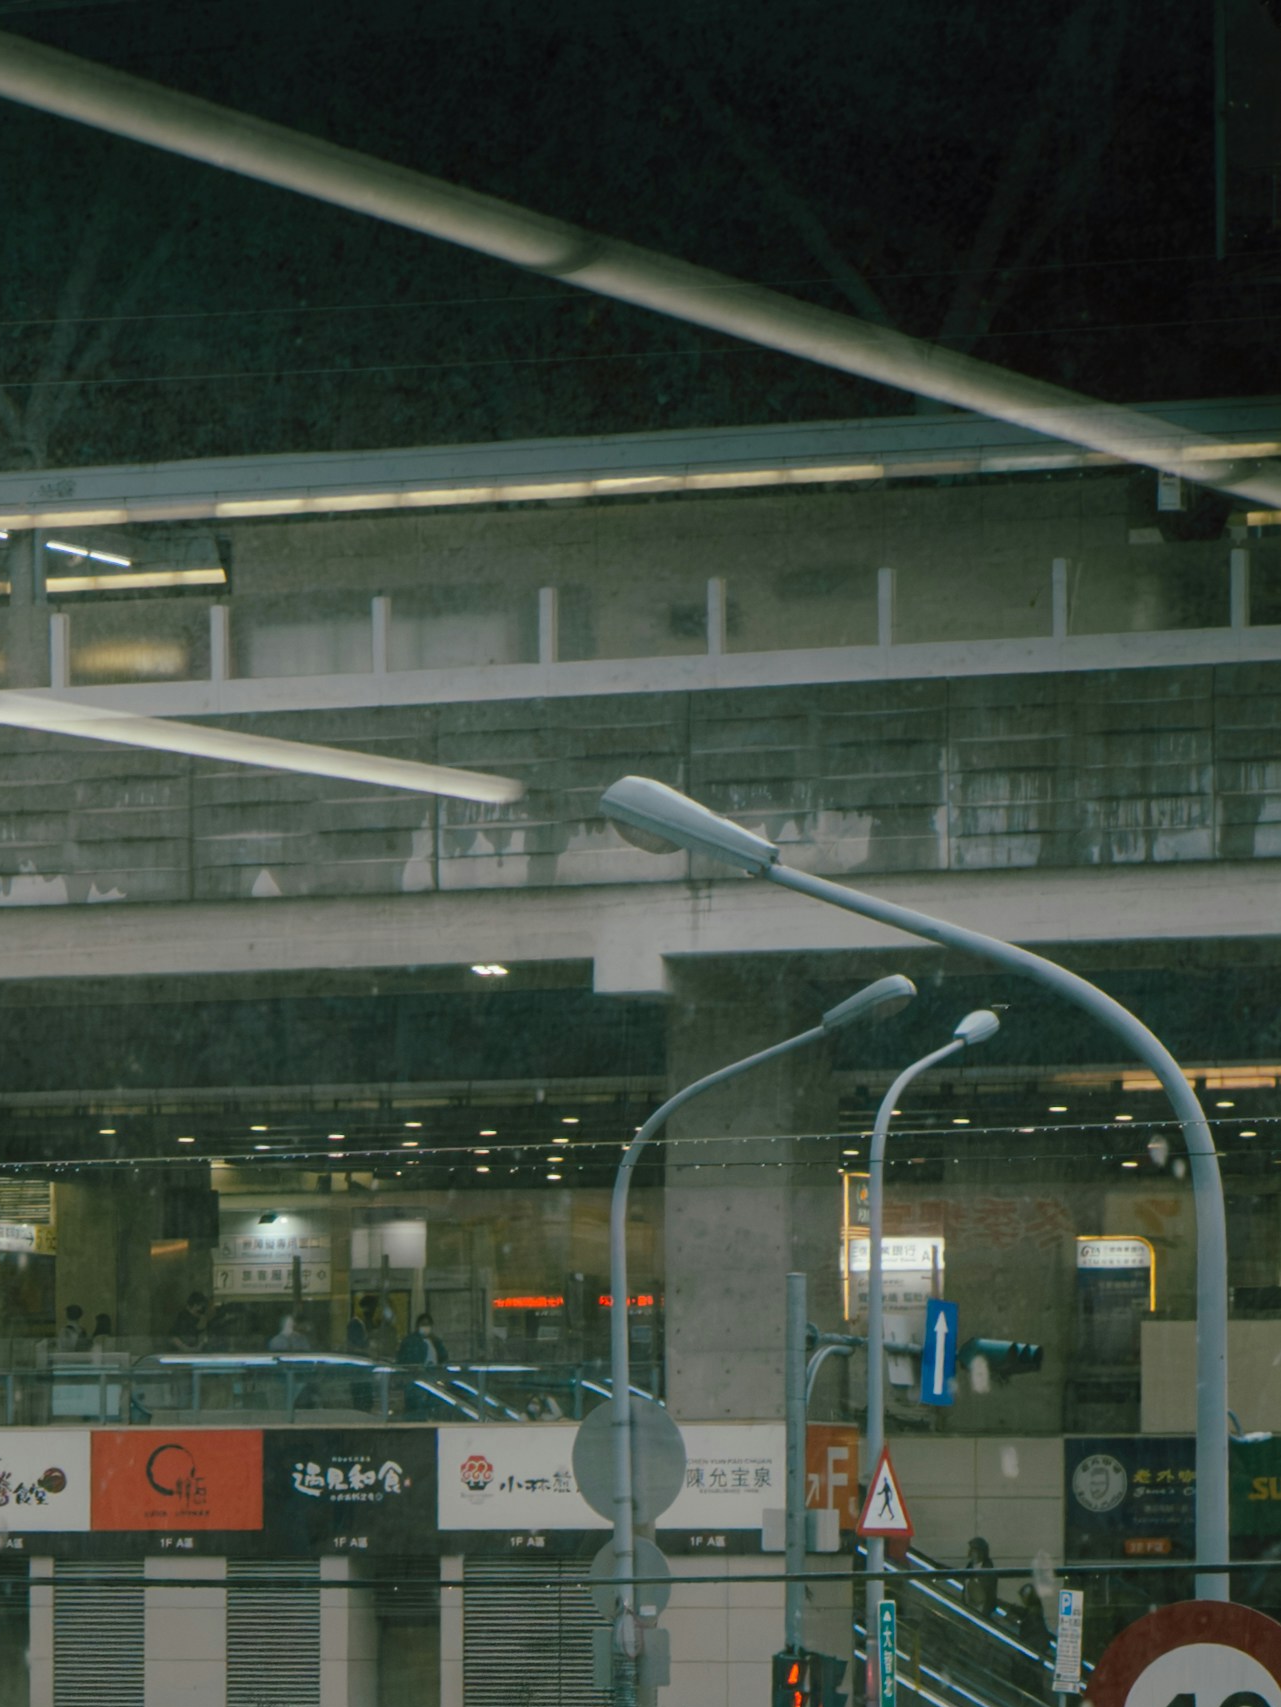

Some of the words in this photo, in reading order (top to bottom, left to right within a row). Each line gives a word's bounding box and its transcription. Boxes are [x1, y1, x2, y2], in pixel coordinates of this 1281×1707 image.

[292, 1461, 403, 1496] 遇見和食
[686, 1467, 773, 1489] 陳允宝泉
[1132, 1469, 1196, 1483] 老外咖
[500, 1472, 579, 1493] 小林煎
[6, 1538, 24, 1549] A區
[160, 1538, 173, 1548] 1F
[176, 1538, 194, 1548] A區
[334, 1537, 346, 1547] 1F
[350, 1537, 368, 1548] A區
[510, 1537, 523, 1547] 1F
[527, 1537, 545, 1547] A區
[690, 1536, 702, 1546] 1F
[707, 1536, 726, 1547] A區
